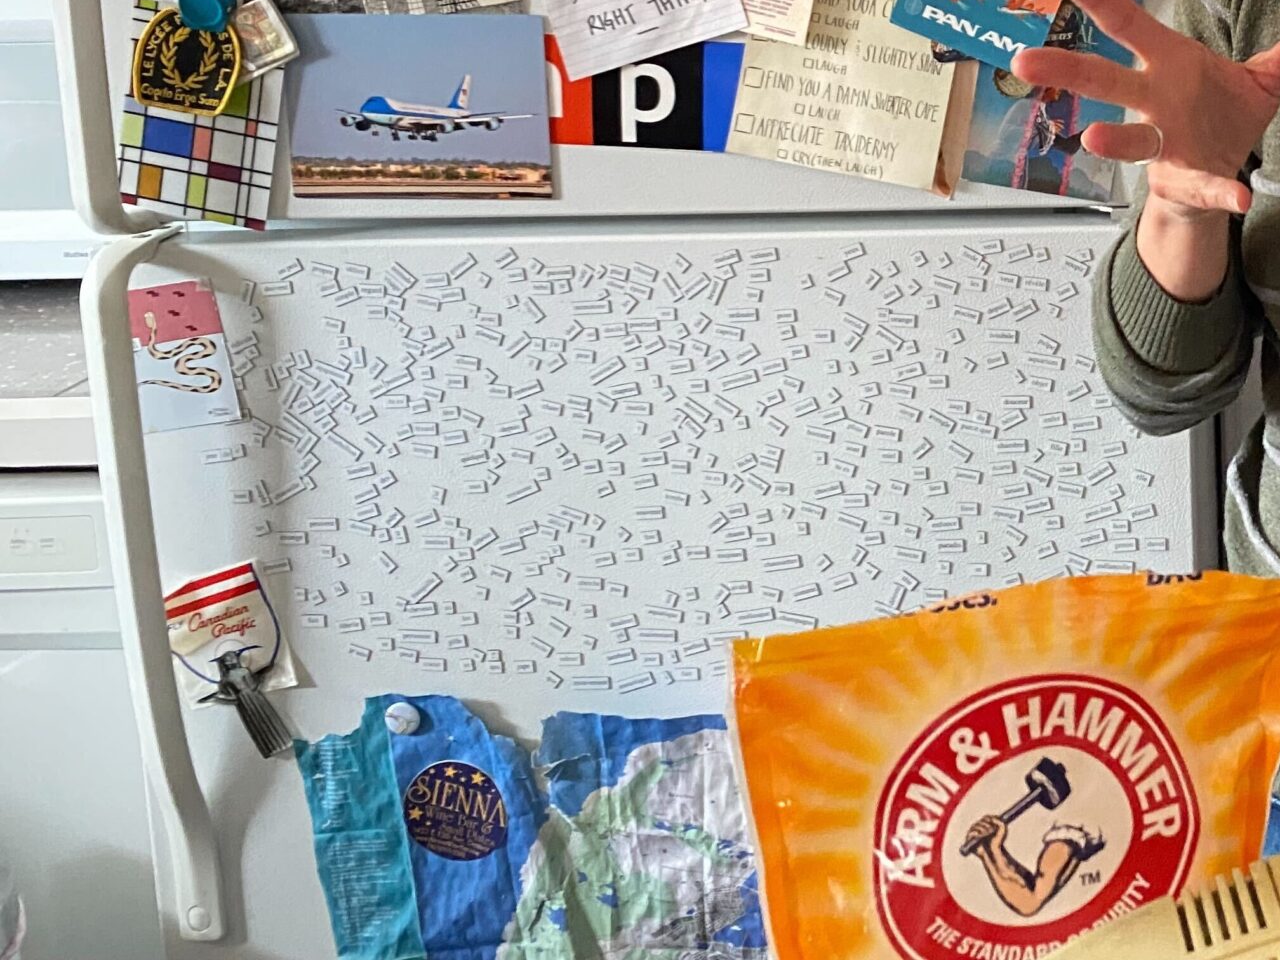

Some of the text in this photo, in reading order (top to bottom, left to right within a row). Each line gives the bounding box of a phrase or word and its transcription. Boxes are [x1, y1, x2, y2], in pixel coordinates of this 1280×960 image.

[587, 2, 636, 37] RIGHT
[824, 16, 860, 31] LAUGH
[921, 3, 981, 39] PAN
[976, 30, 1026, 54] AM
[814, 59, 848, 76] LAUGH
[863, 44, 918, 71] SLIGHTLY
[141, 83, 220, 108] Cogito Ergo Sum
[765, 69, 794, 90] FIND
[799, 77, 821, 98] YOU
[825, 83, 834, 102] A
[836, 85, 871, 108] DAMN
[914, 100, 940, 123] CAPE
[808, 106, 841, 122] LAUGH
[754, 117, 900, 163] APPRECIATE TAXIDERMY
[188, 604, 249, 633] Canadian
[212, 618, 257, 639] Pacific
[407, 774, 506, 829] SIENNA
[898, 690, 1183, 890] ARM & HAMMER
[925, 915, 960, 945] THE
